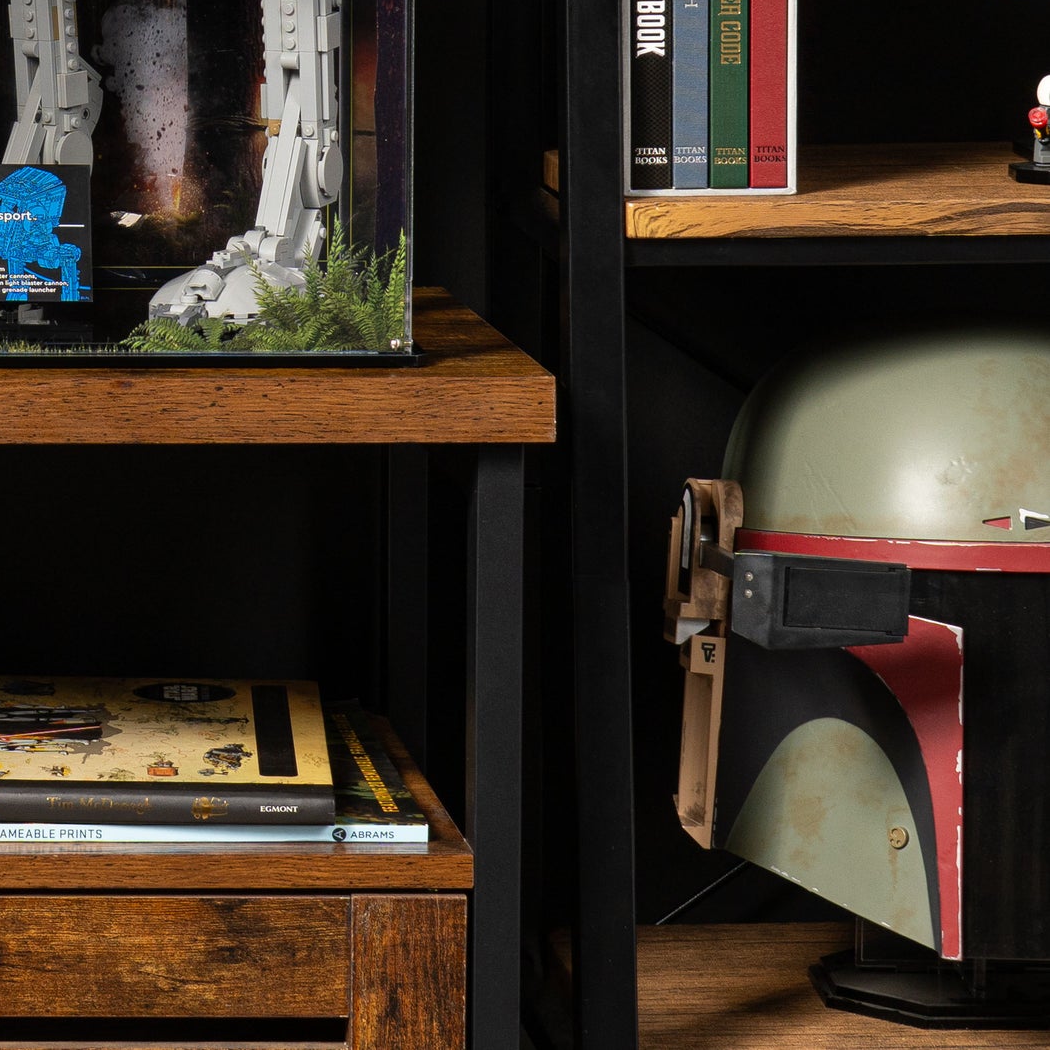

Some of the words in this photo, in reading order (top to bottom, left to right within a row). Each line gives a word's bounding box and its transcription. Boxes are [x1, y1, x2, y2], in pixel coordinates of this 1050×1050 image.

[720, 20, 741, 64] CODE
[716, 148, 745, 156] TITAN
[635, 156, 668, 164] BOOKS
[673, 156, 707, 164] BOOKS
[260, 805, 298, 813] EGMONT
[60, 829, 102, 839] PRINTS
[350, 830, 395, 839] ABRAMS
